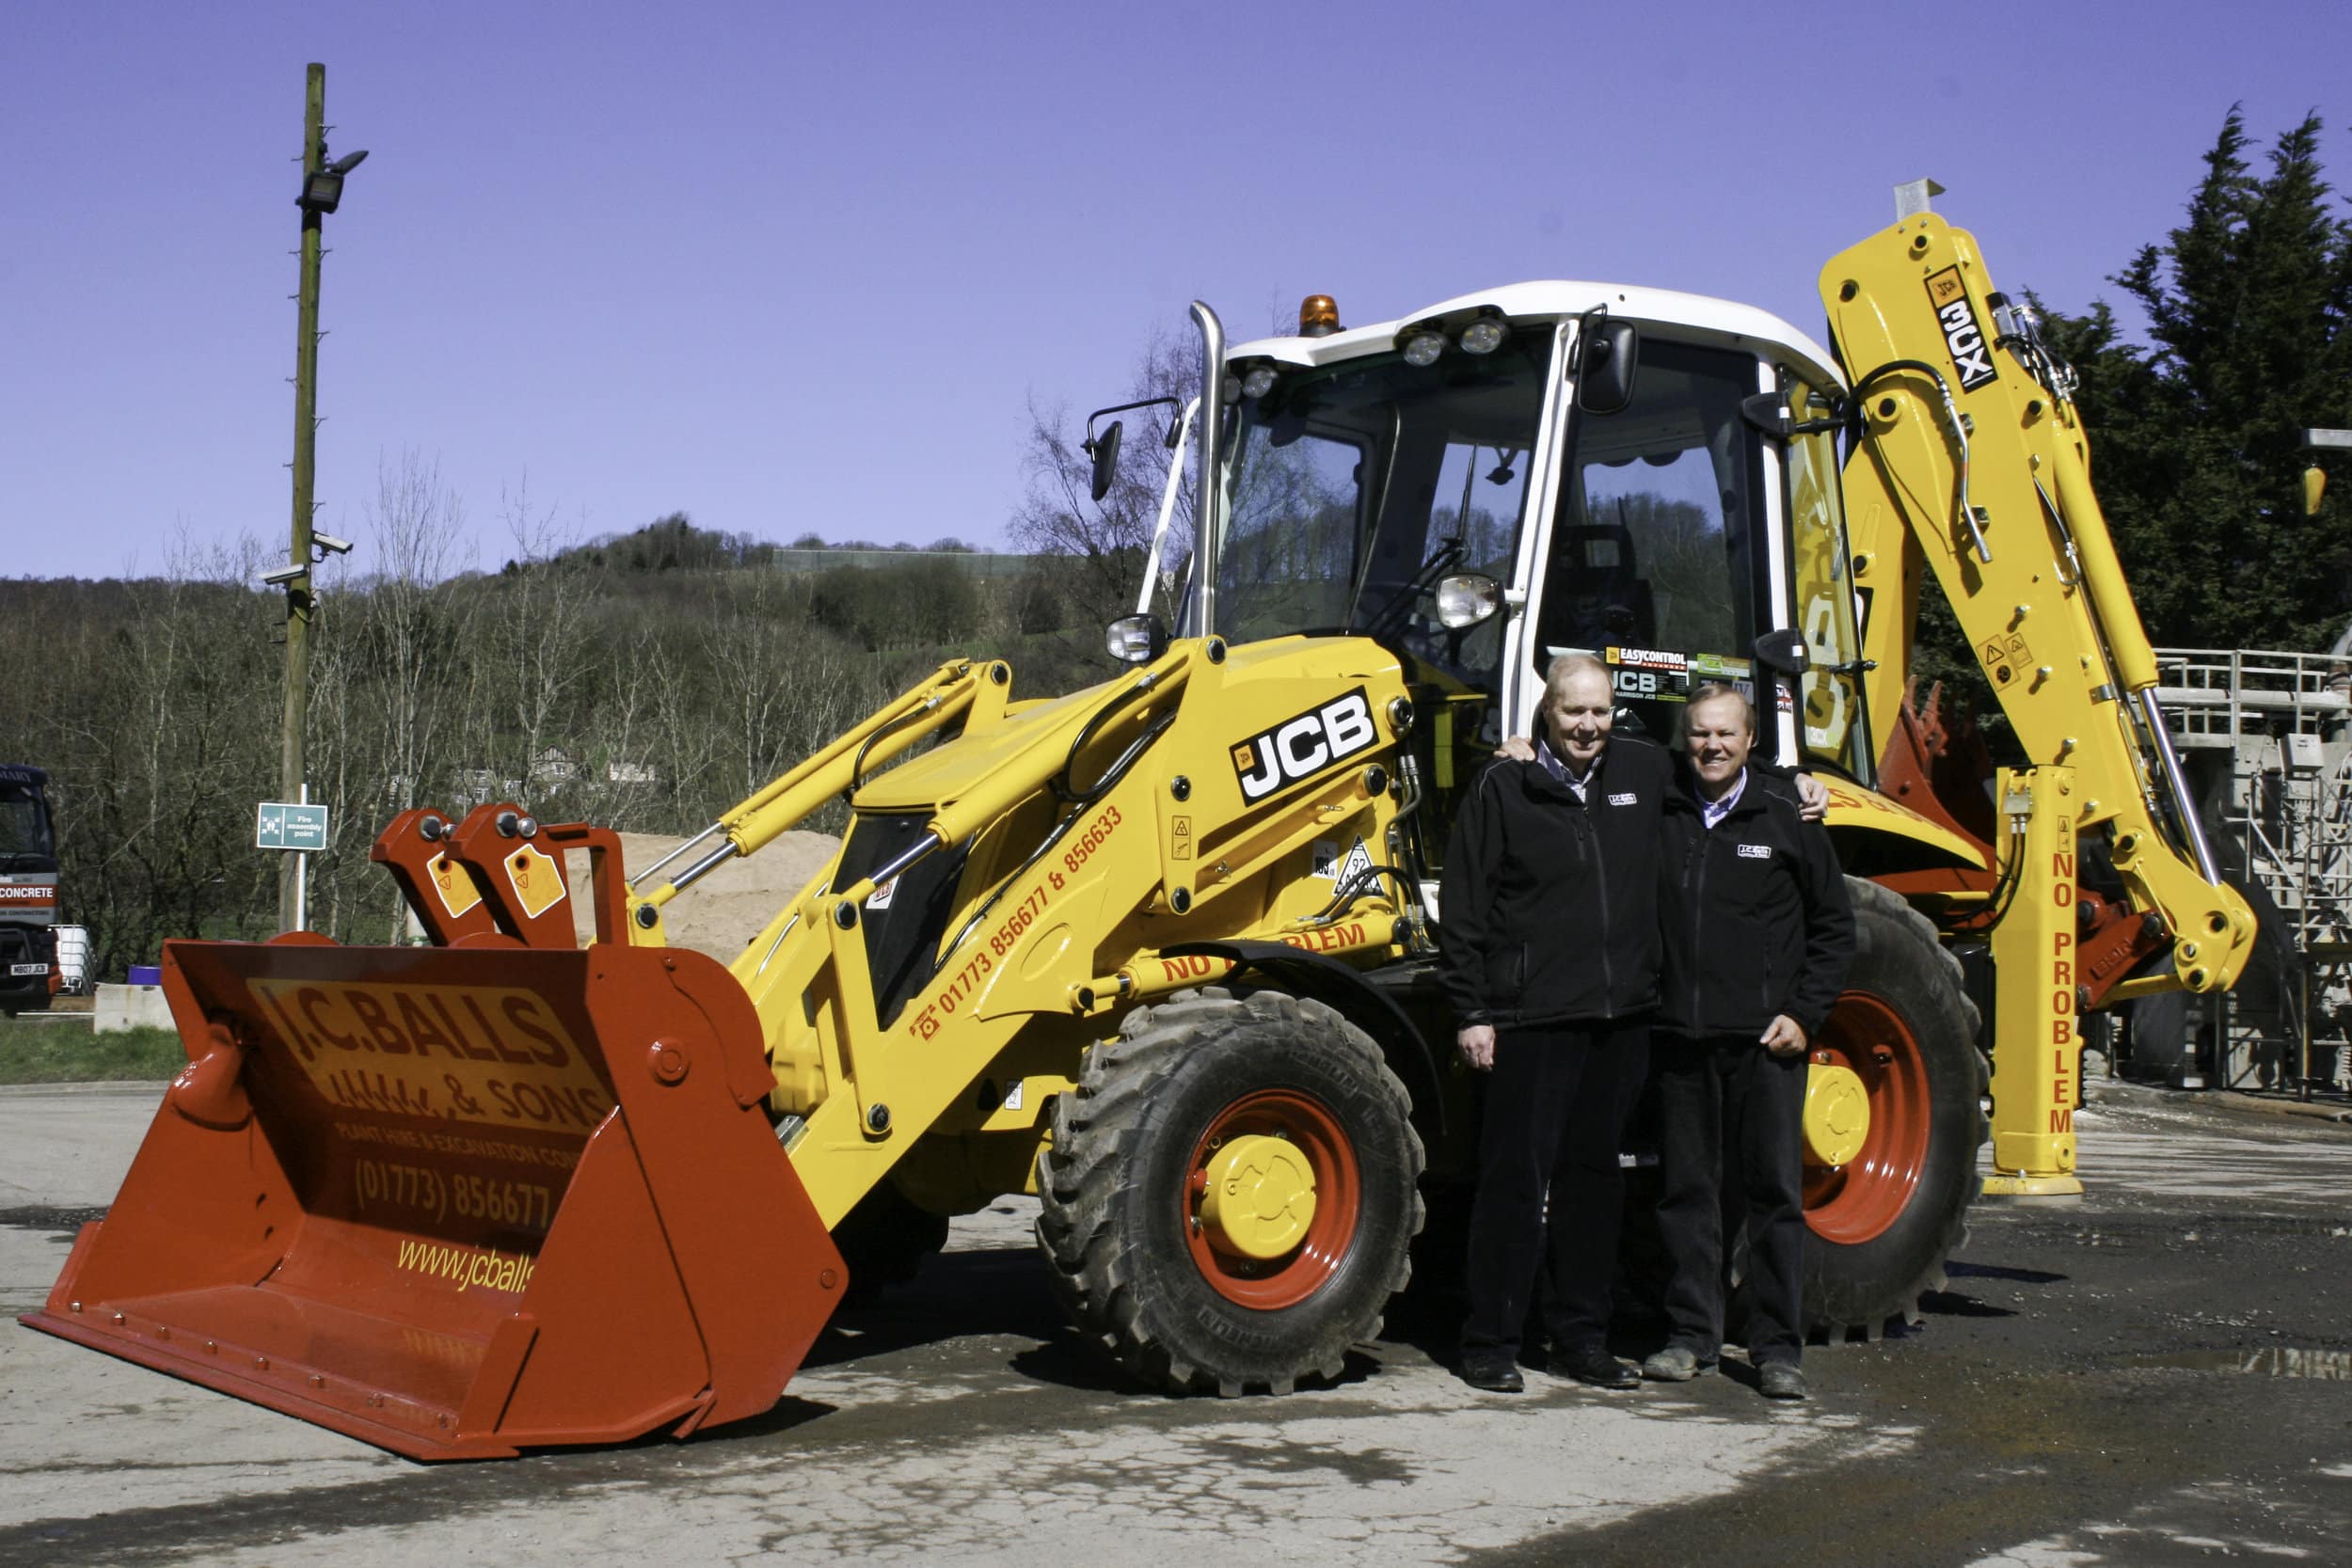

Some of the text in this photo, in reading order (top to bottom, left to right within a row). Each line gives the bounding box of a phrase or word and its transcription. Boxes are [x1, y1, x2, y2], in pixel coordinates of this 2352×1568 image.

[1940, 300, 1993, 384] 3CX
[1613, 670, 1657, 692] JCB
[1620, 647, 1687, 665] EASYCONTROL
[1241, 694, 1374, 798] JCB
[286, 823, 322, 832] assembly
[0, 887, 54, 898] CONCRETE
[939, 805, 1121, 1014] 01773 856677 & 856633
[1162, 954, 1212, 981] NO
[2049, 853, 2074, 1134] NO PROBLEM
[260, 985, 570, 1068] J.C.BALLS
[444, 1073, 612, 1127] & SONS
[435, 1133, 540, 1165] EXCAVATION
[355, 1158, 550, 1229] (01773) 856677
